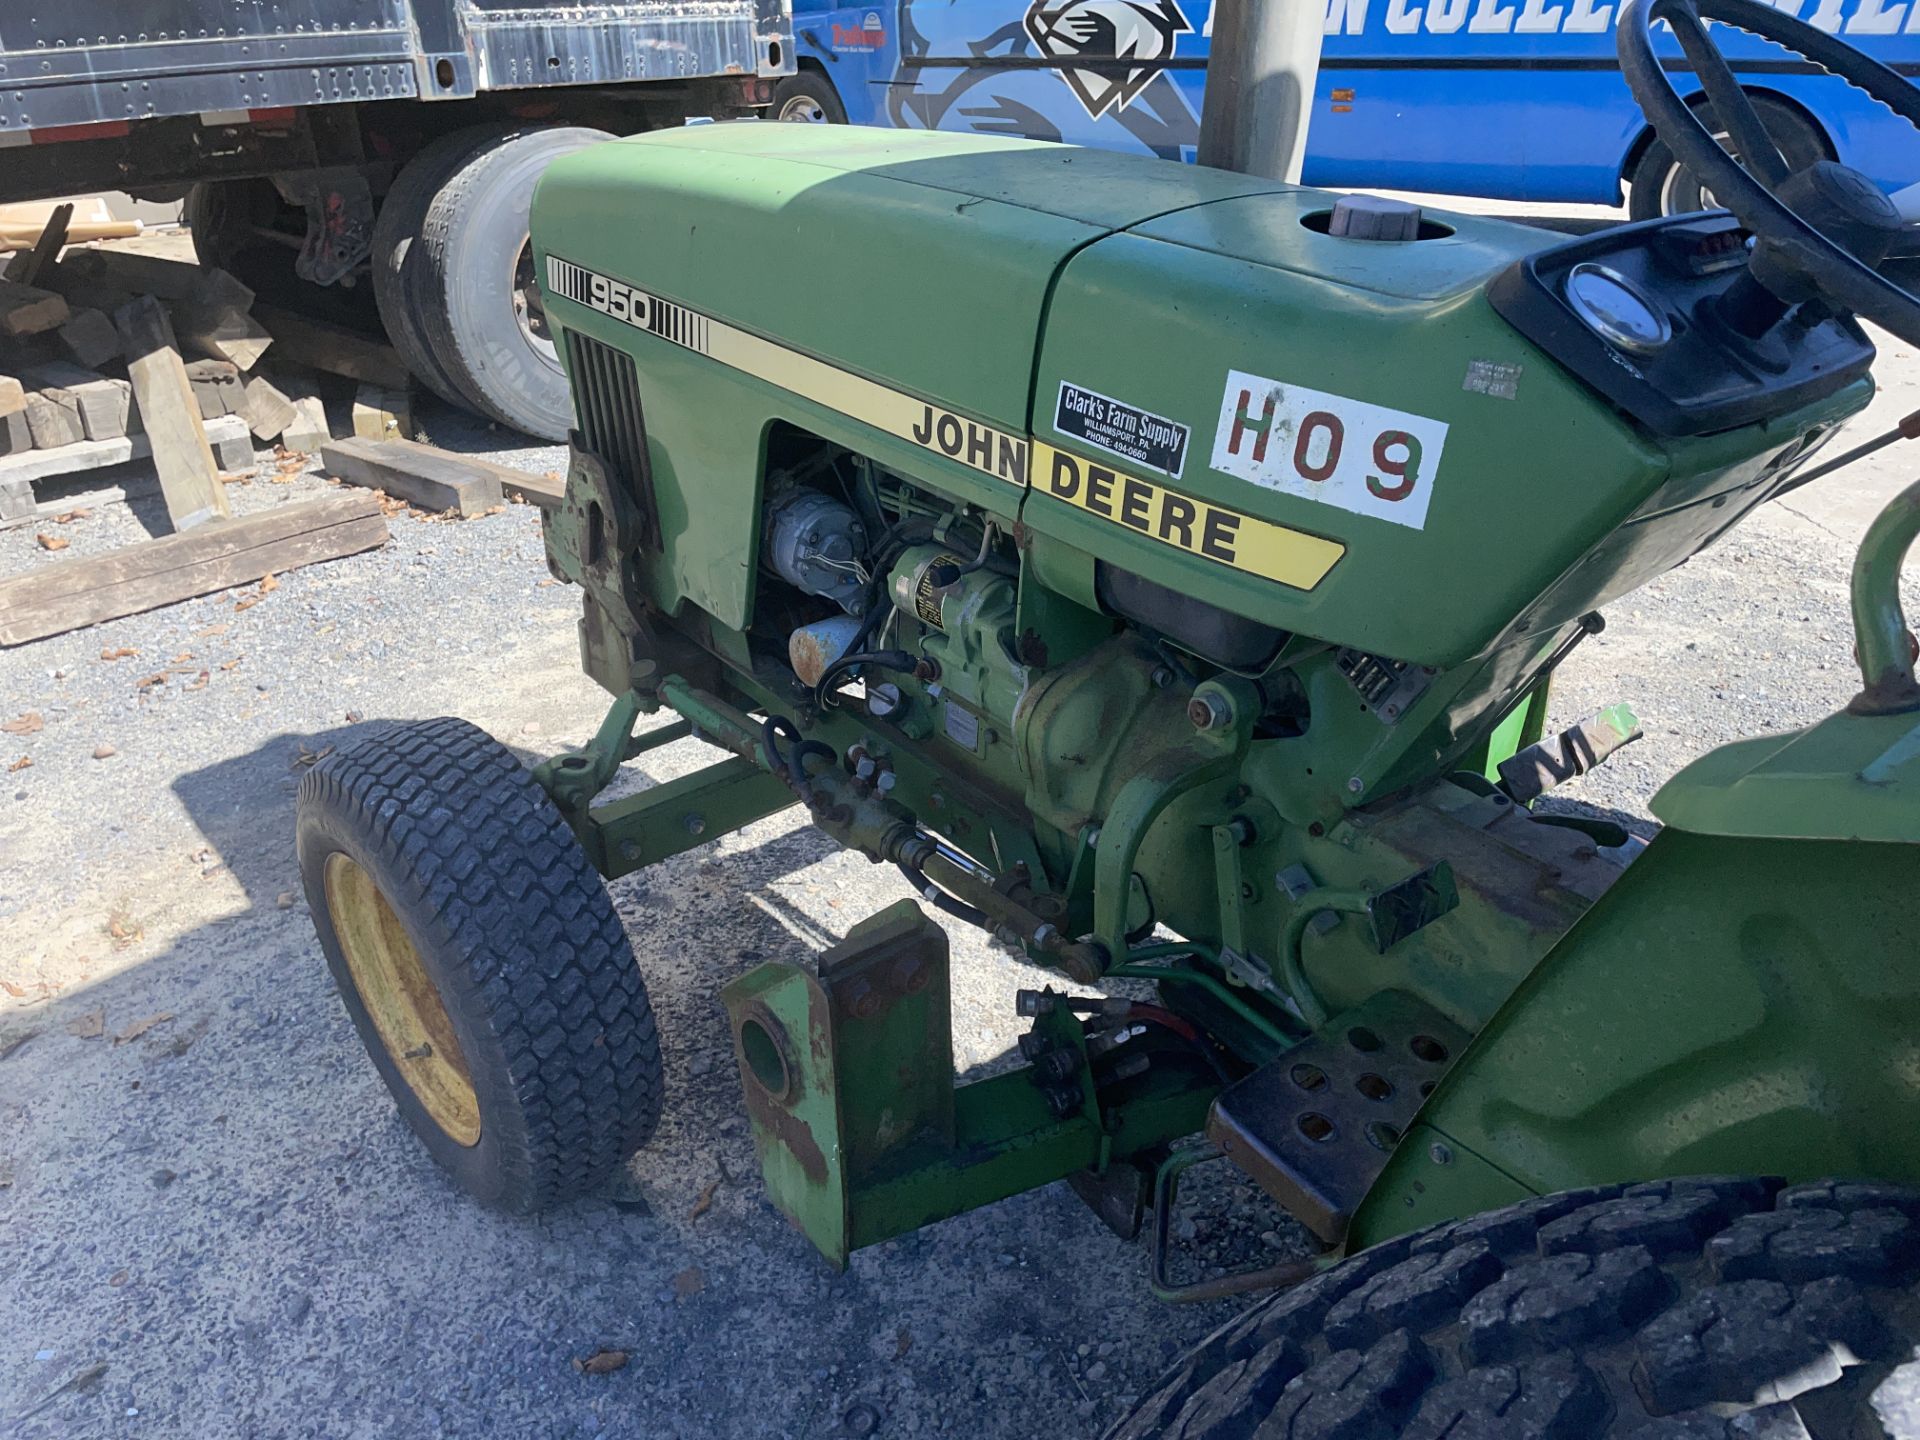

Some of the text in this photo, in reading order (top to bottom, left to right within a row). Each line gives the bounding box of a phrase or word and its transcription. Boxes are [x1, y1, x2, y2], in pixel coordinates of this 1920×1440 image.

[591, 274, 651, 329] 950
[1065, 389, 1182, 452] Clark's Farm Supply
[1085, 430, 1147, 460] PHONE: 494-0660
[912, 405, 1241, 563] JOHN DEERE
